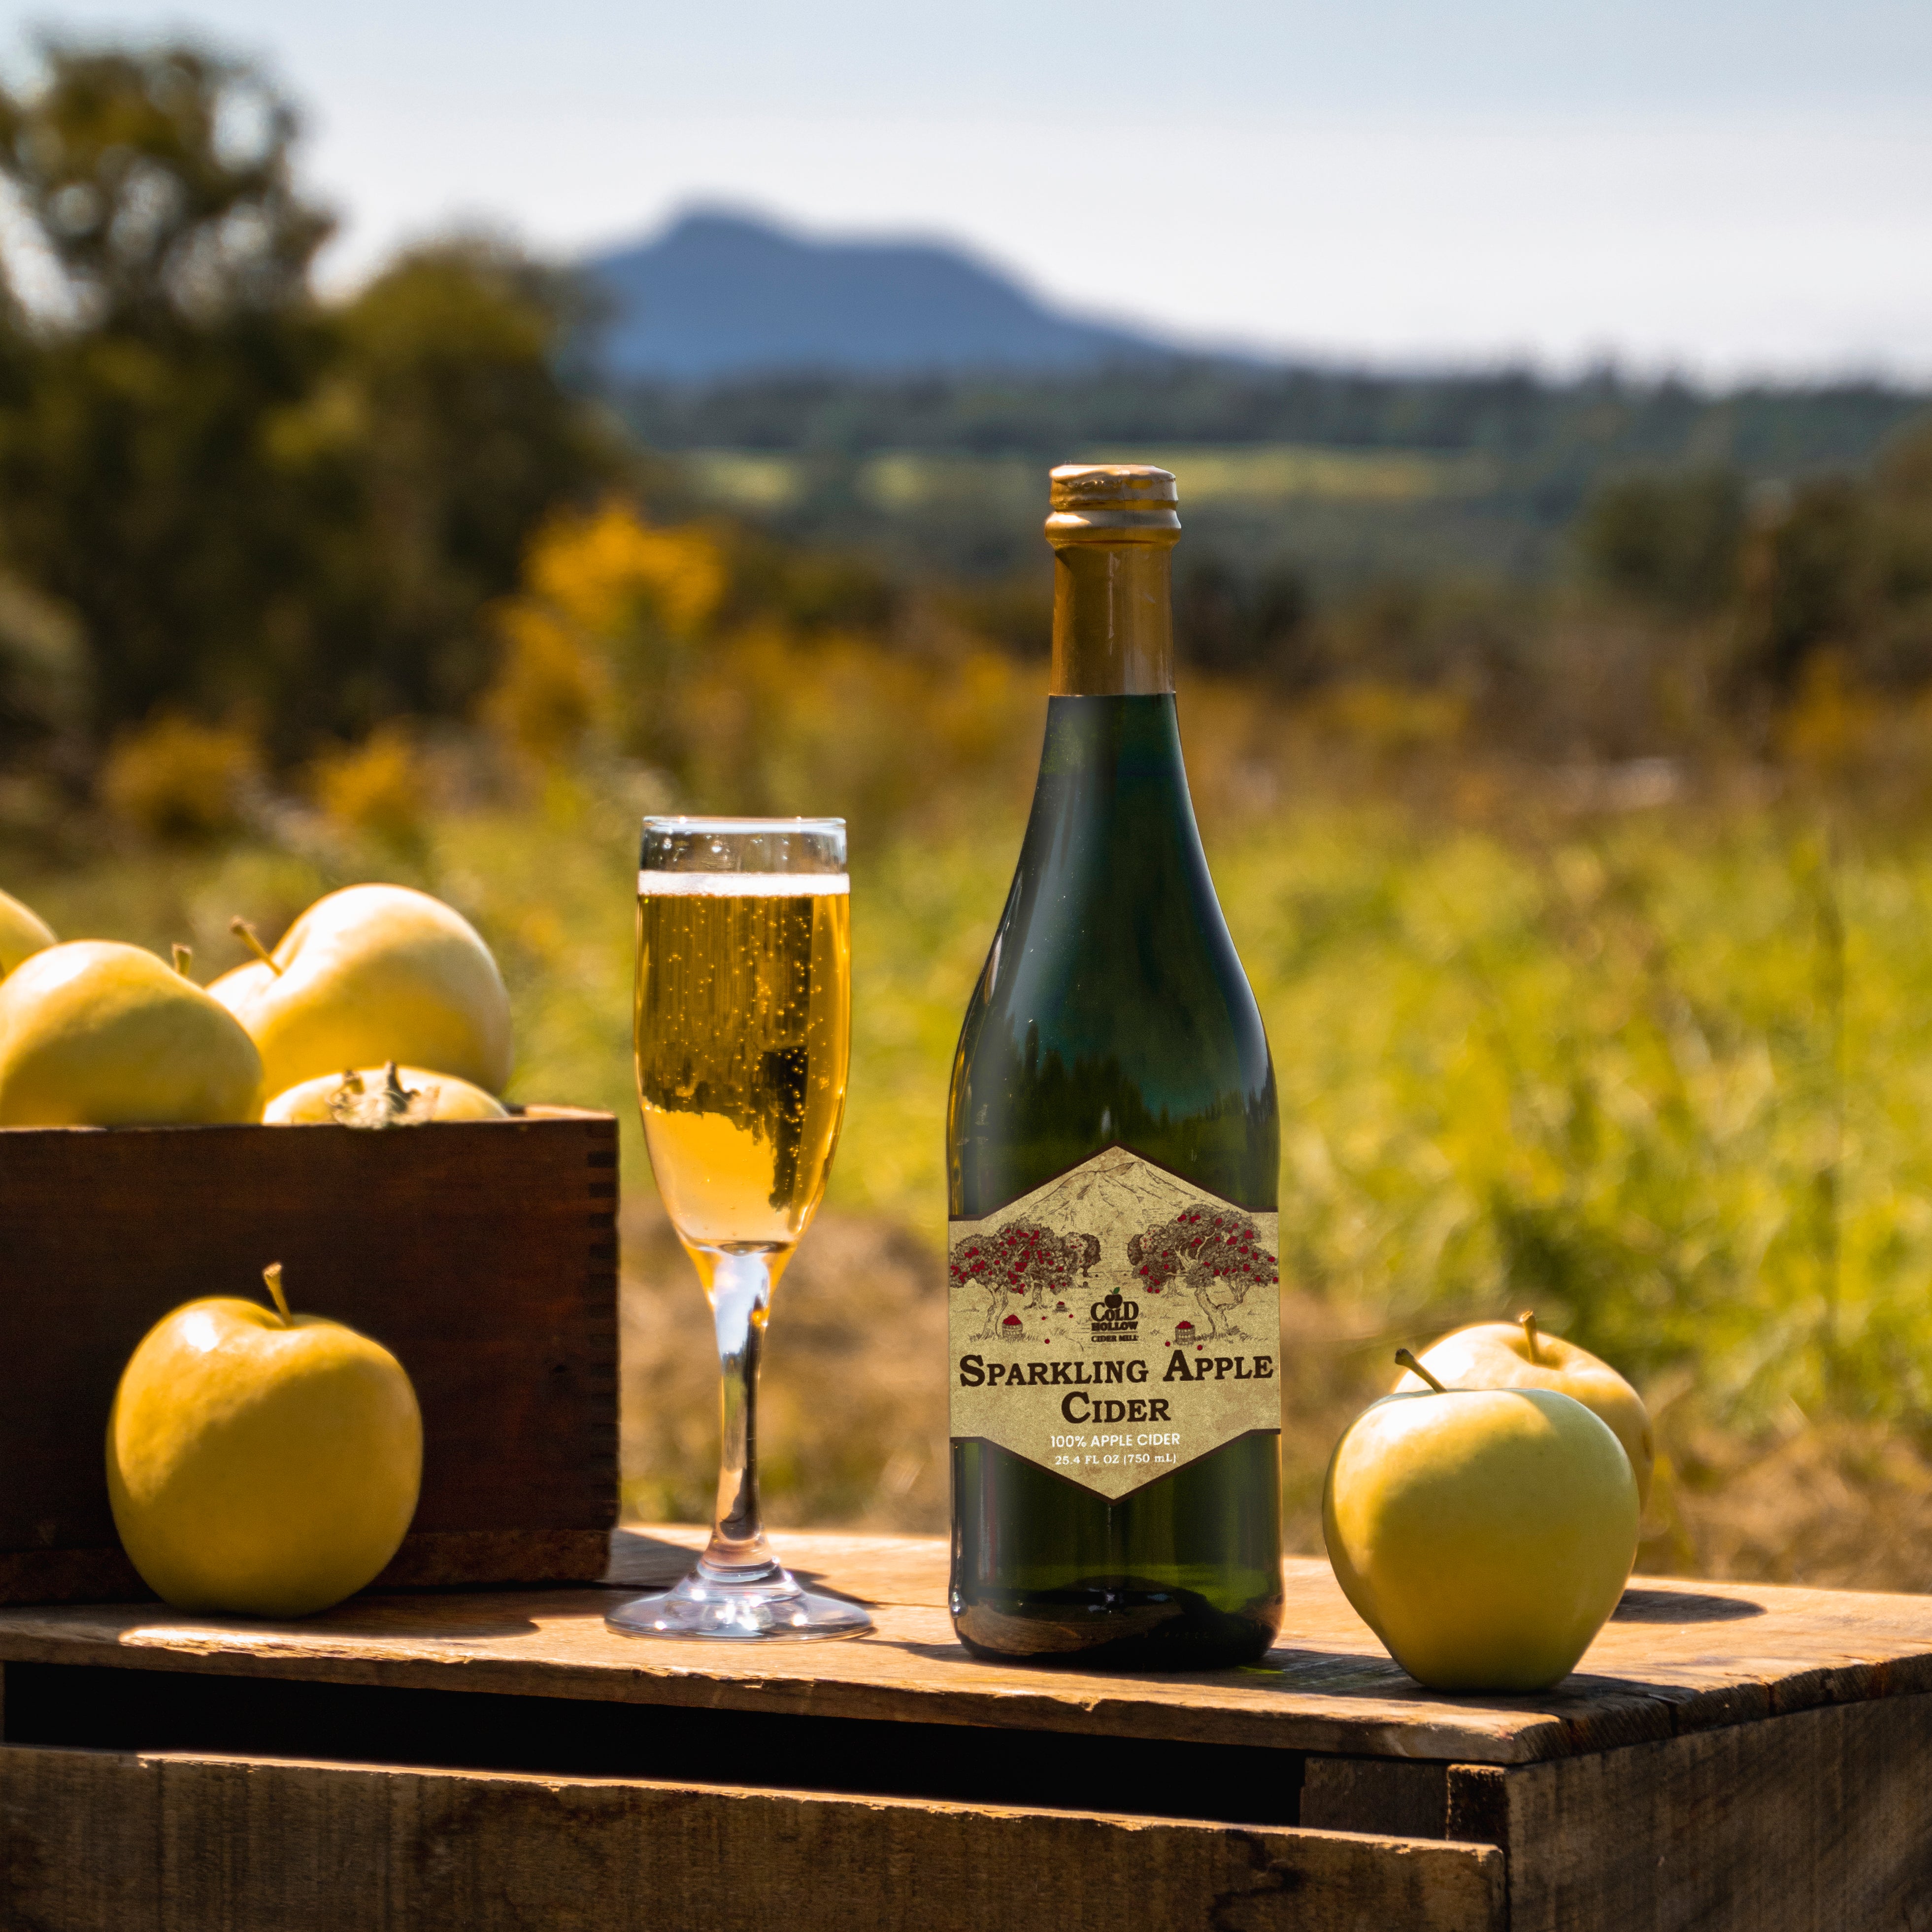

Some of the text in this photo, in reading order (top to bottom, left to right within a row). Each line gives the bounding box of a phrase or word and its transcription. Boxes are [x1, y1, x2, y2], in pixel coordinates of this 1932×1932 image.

[1090, 1301, 1139, 1322] COLD
[1091, 1321, 1139, 1332] HOLLOW
[959, 1349, 1274, 1387] SPARKLING APPLE
[1061, 1391, 1171, 1424] CIDER
[1050, 1432, 1181, 1448] 100% APPLE CIDER
[1055, 1453, 1177, 1466] 25.4 FL OZ (750 mL)
